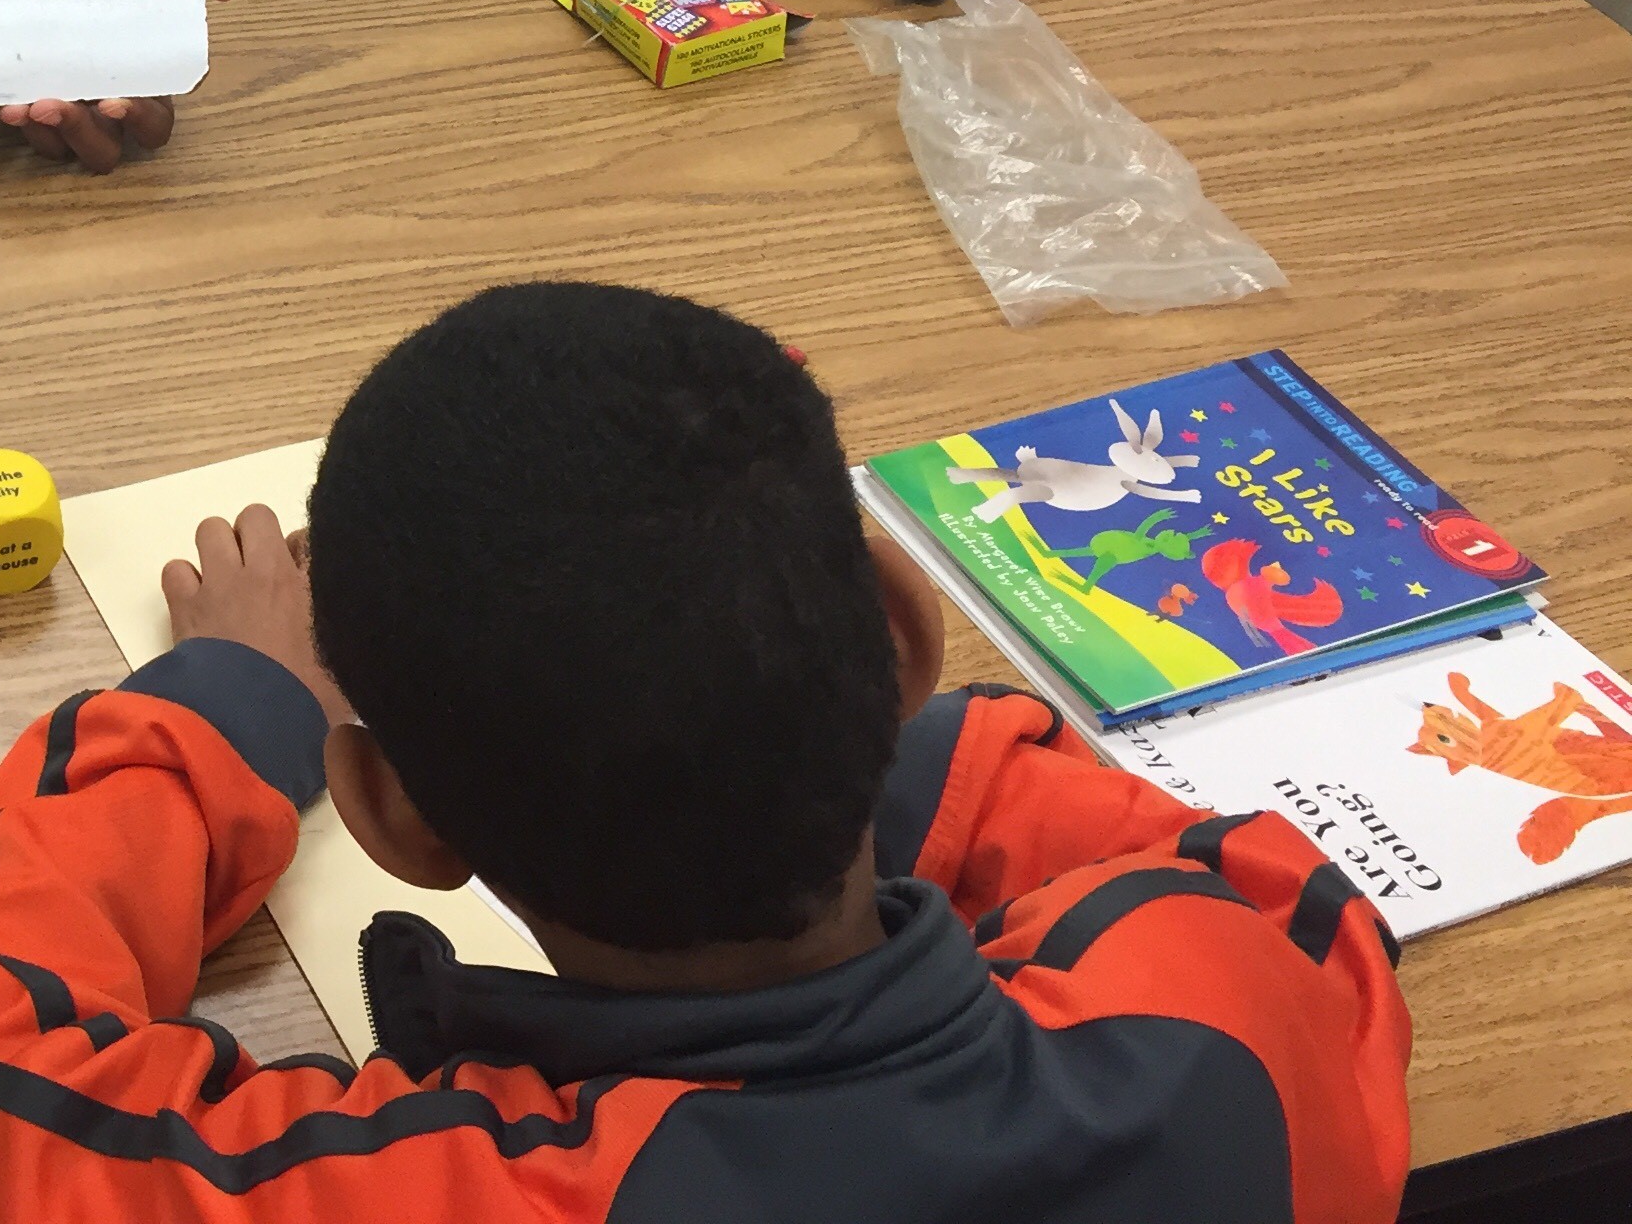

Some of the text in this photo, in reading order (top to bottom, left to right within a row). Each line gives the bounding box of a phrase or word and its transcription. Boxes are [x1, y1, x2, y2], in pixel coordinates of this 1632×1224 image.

[1263, 364, 1418, 493] STEP INTO READING
[1215, 464, 1315, 543] Stars
[1249, 448, 1355, 536] I Like
[1374, 479, 1440, 531] ready to read
[0, 541, 32, 556] at a
[961, 514, 1087, 633] By Margaret Wise Brown
[1461, 539, 1497, 556] 1
[996, 572, 1014, 586] by
[1013, 589, 1042, 614] Joan
[1272, 777, 1414, 901] Are You
[1315, 781, 1443, 892] Going?
